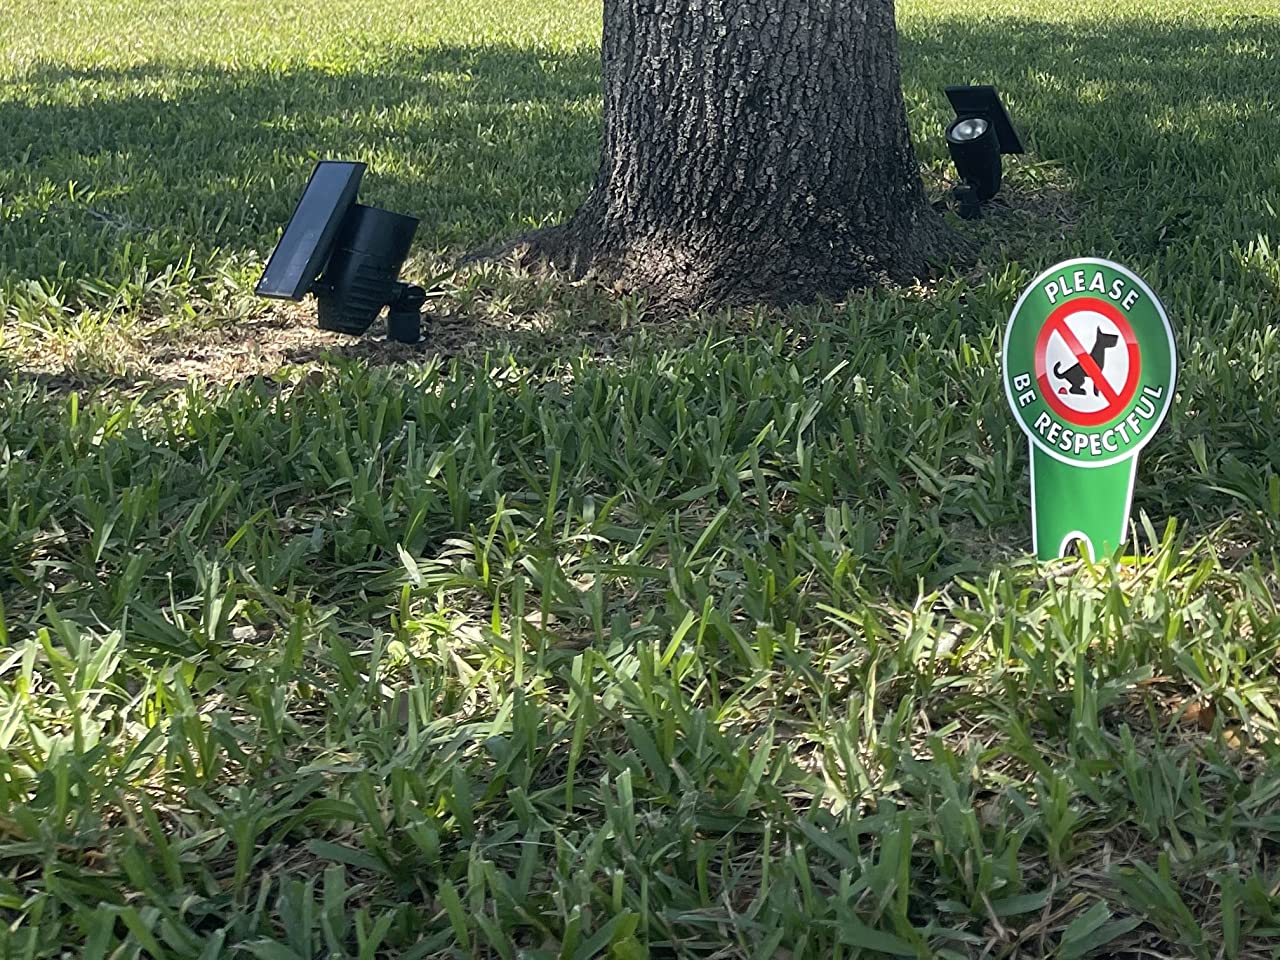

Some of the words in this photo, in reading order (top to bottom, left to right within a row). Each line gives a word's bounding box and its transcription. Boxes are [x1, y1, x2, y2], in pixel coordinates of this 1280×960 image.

[1044, 271, 1139, 311] PLEASE
[1012, 373, 1037, 407] BE
[1034, 384, 1163, 456] RESPECTFUL
